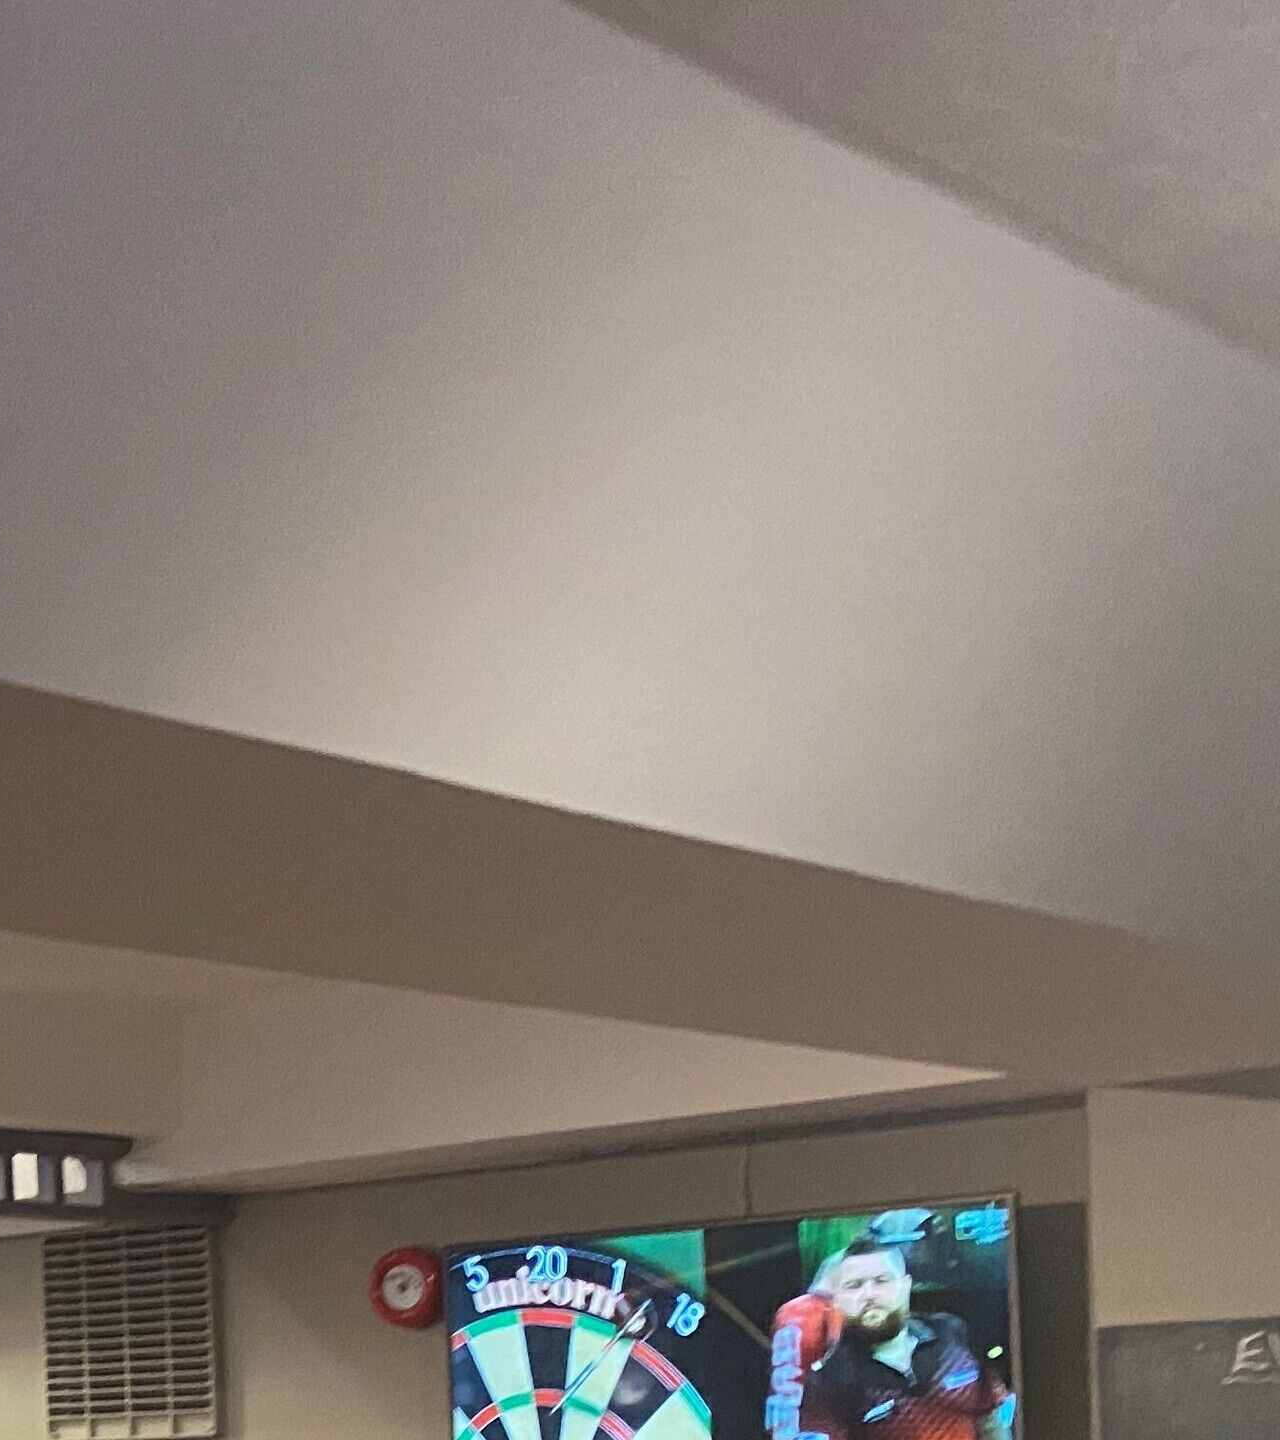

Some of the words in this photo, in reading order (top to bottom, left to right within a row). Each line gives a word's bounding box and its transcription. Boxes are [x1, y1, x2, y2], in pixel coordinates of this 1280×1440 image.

[462, 1255, 490, 1293] 5
[526, 1245, 569, 1282] 20
[611, 1258, 627, 1297] 1
[666, 1292, 705, 1337] 18
[472, 1266, 624, 1319] unicorn
